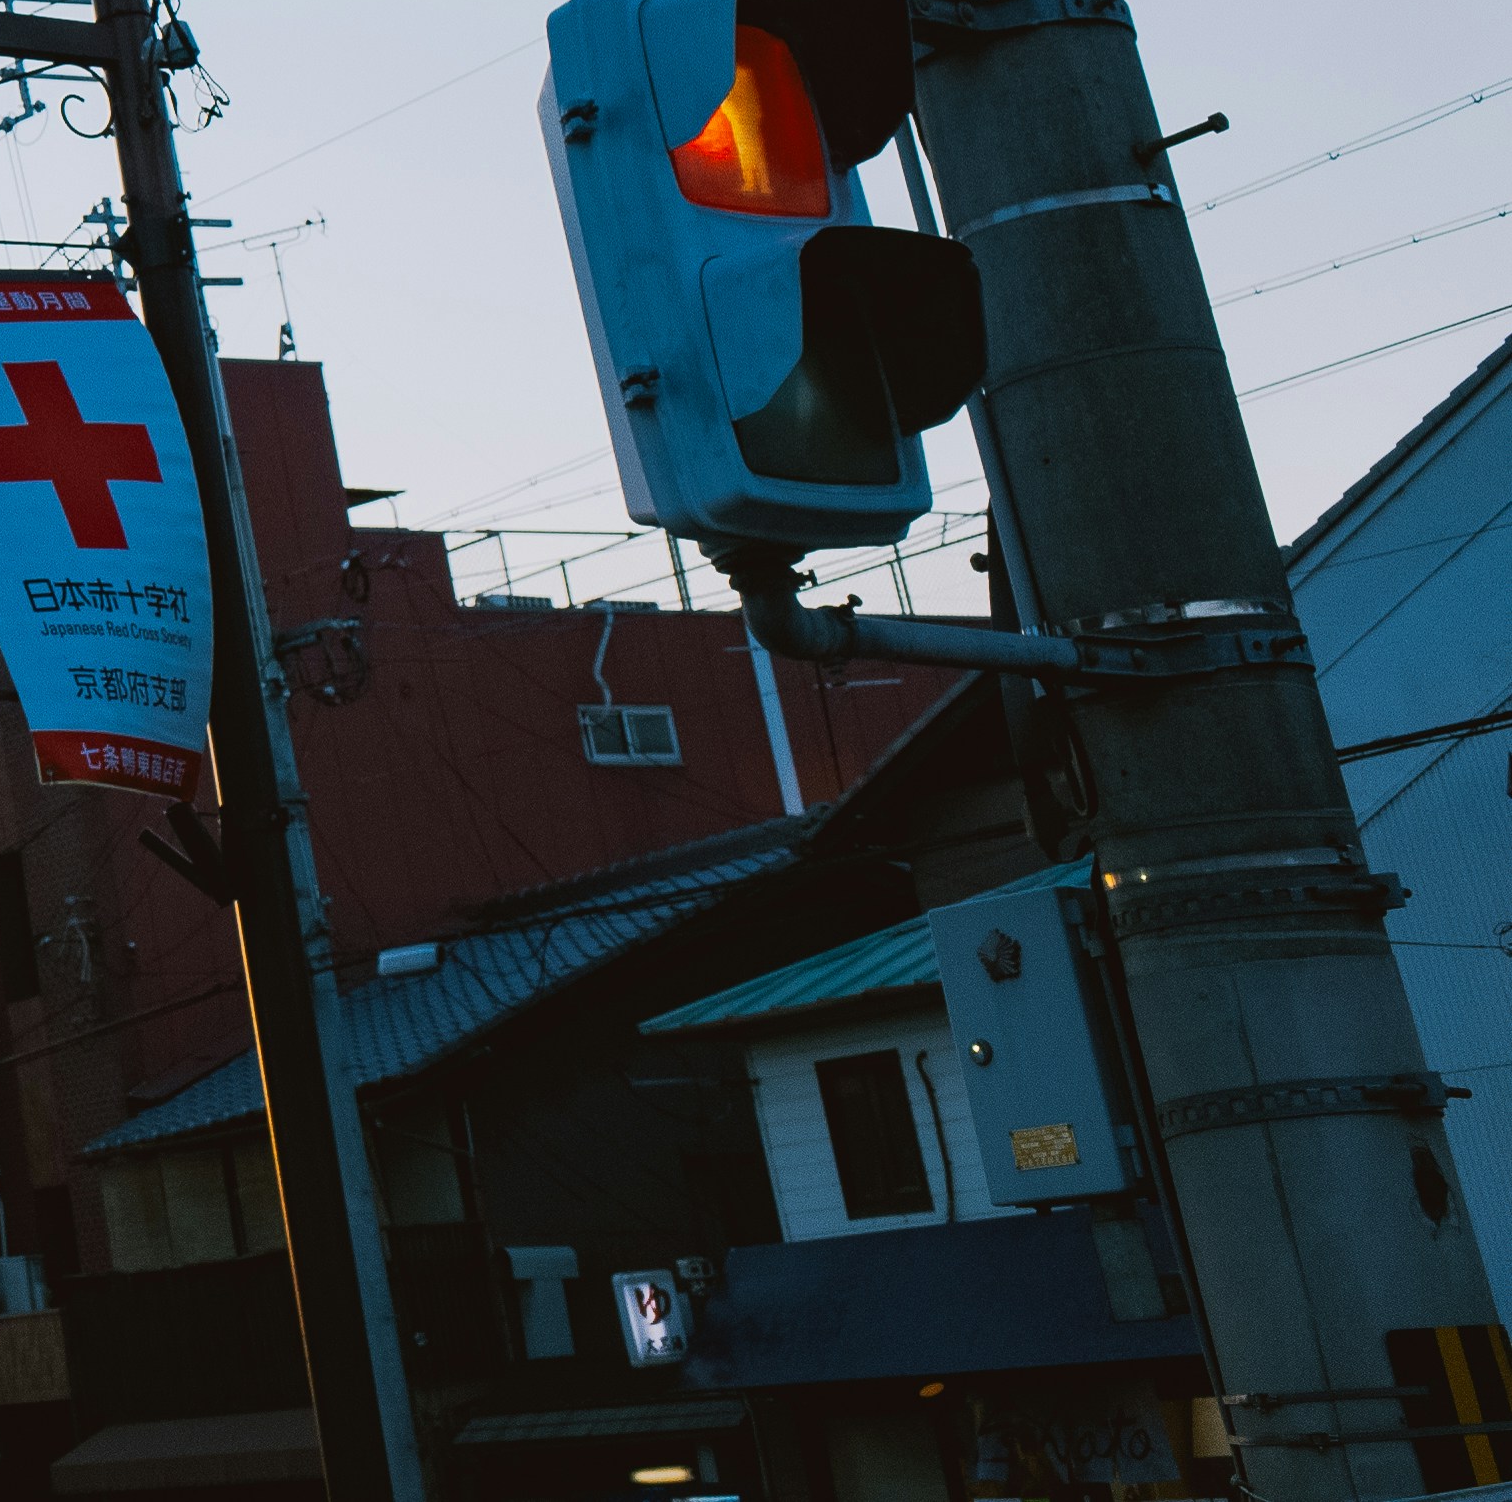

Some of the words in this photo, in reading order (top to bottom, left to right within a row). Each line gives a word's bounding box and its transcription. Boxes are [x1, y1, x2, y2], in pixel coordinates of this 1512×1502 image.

[23, 577, 190, 624] 日本赤十字社
[40, 620, 104, 638] Japanese
[106, 620, 129, 638] Red
[130, 622, 160, 642] Cross
[160, 627, 192, 652] Society
[68, 664, 187, 712] 京都府支部
